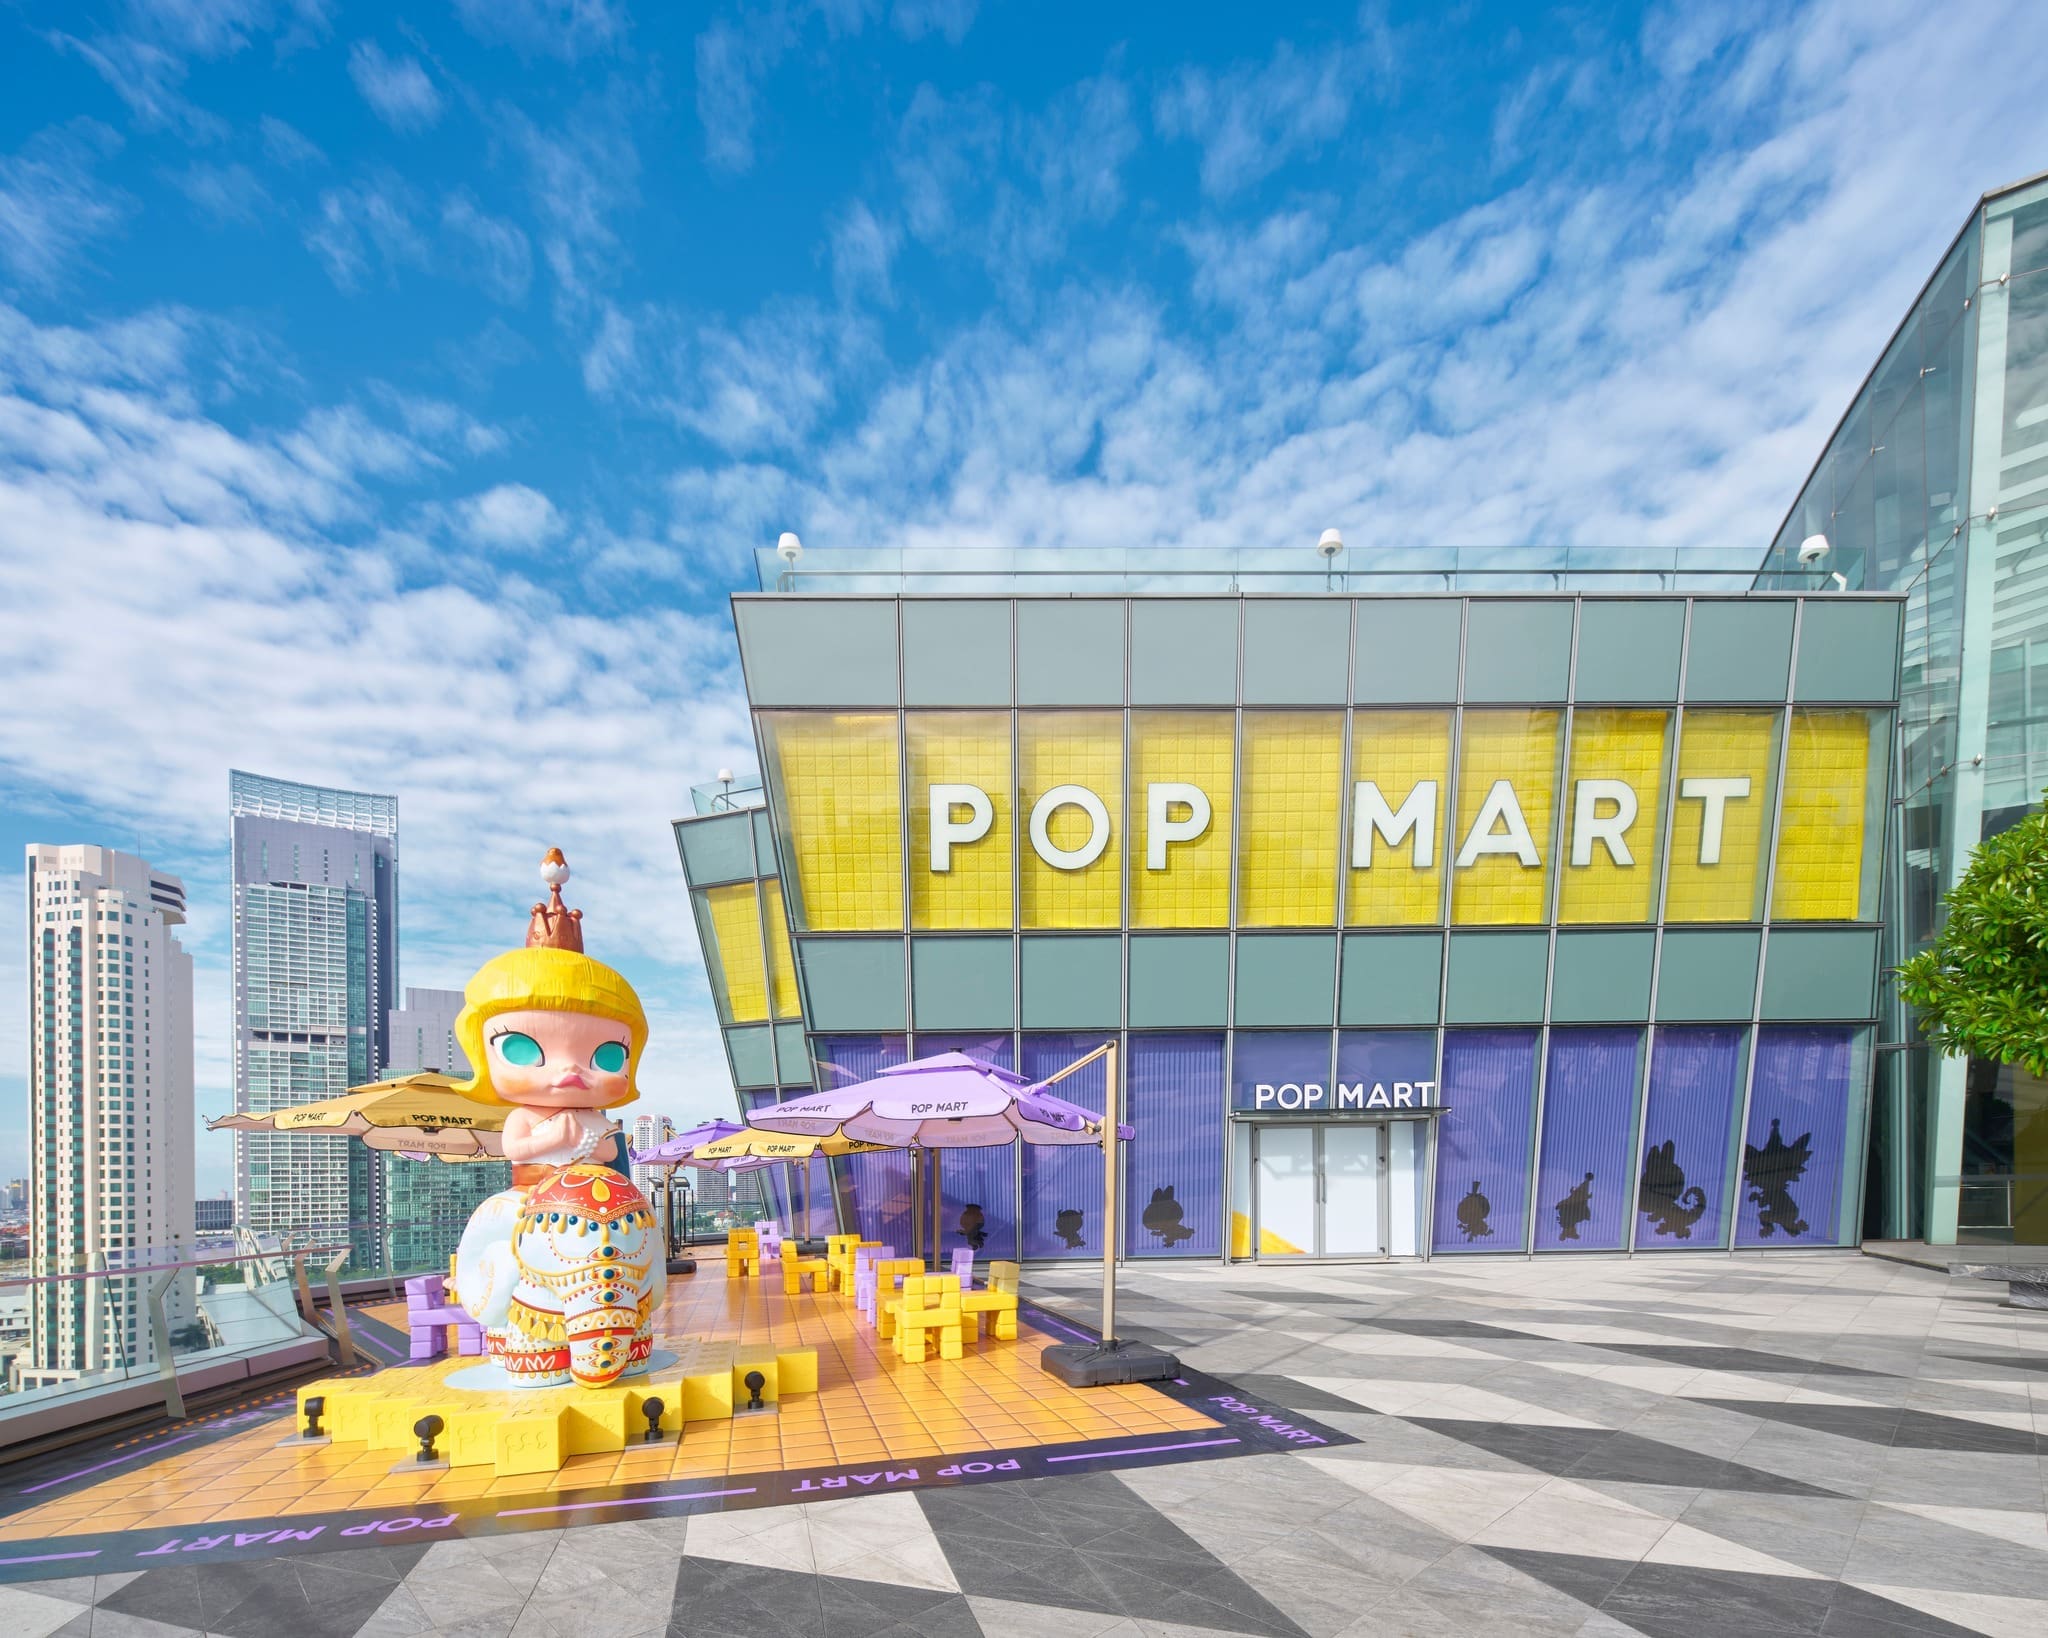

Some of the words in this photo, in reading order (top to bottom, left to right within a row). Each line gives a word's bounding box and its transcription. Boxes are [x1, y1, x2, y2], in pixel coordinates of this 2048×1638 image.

[928, 782, 1213, 872] POP
[1351, 777, 1752, 869] MART
[1254, 1083, 1324, 1110] POP
[1337, 1081, 1436, 1109] MART
[293, 1113, 306, 1122] POP
[307, 1112, 327, 1121] MART
[776, 1105, 798, 1113] POP
[799, 1104, 831, 1113] MART
[911, 1103, 933, 1114] POP
[935, 1101, 968, 1113] MART
[411, 1114, 437, 1122] POP
[440, 1115, 473, 1125] MART
[767, 1145, 778, 1153] POP
[778, 1145, 795, 1153] MART
[848, 1141, 864, 1150] POP
[1208, 1396, 1259, 1414] POP
[1248, 1415, 1329, 1444] MART
[936, 1458, 1021, 1477] POP
[791, 1468, 920, 1493] MART
[340, 1512, 460, 1537] POP
[135, 1525, 327, 1557] MART
